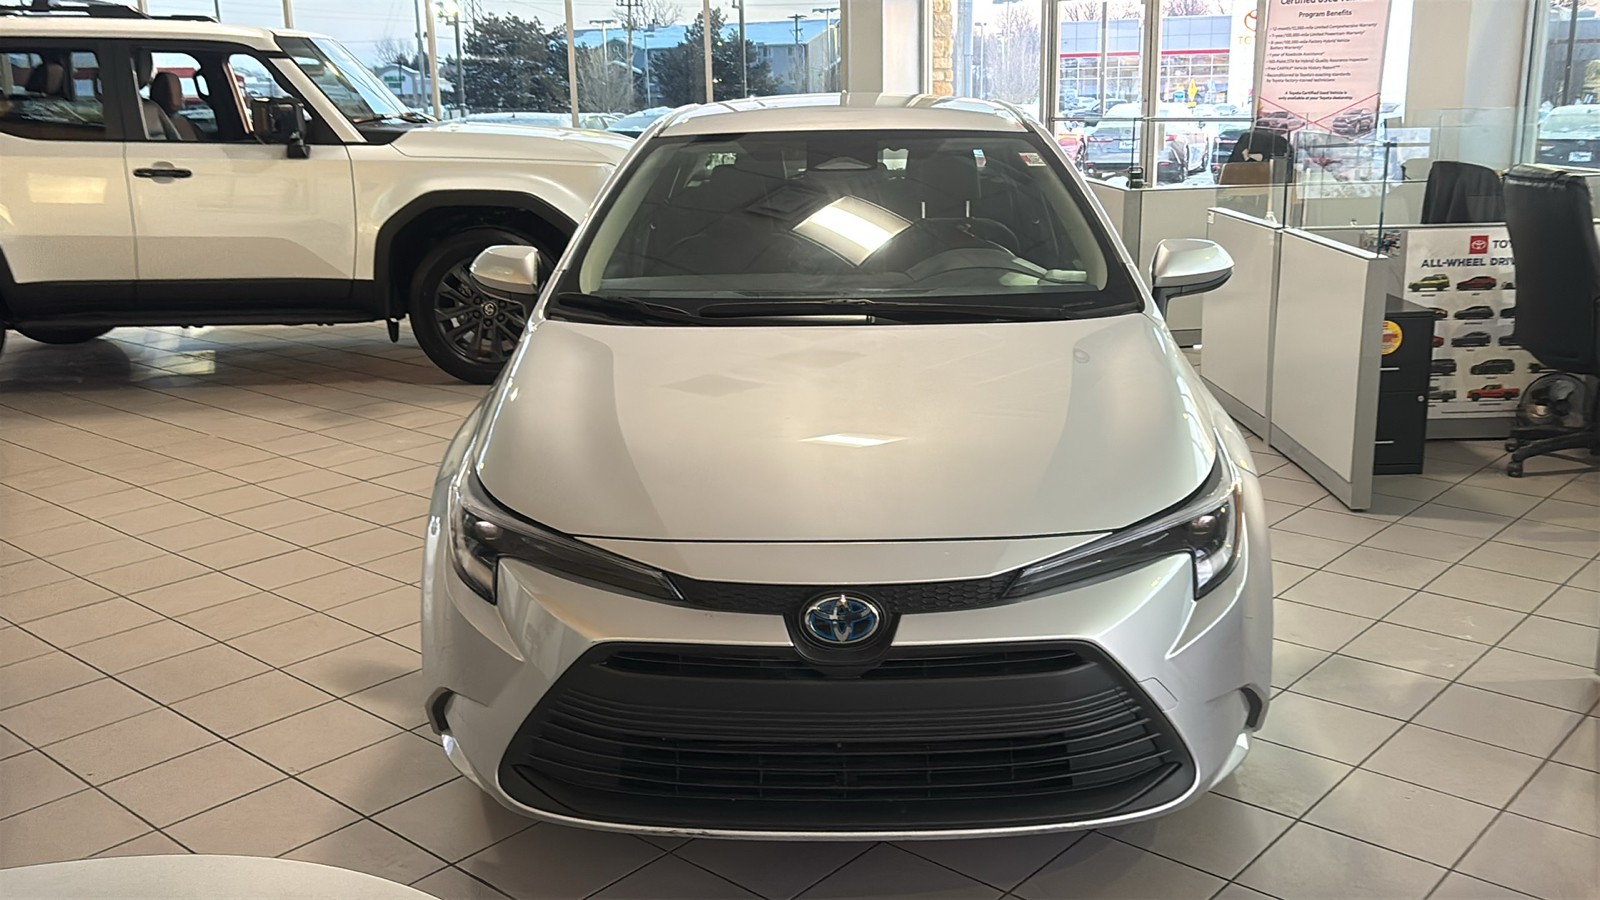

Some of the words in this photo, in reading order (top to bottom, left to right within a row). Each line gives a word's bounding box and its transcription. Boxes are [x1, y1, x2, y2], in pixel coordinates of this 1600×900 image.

[1298, 11, 1325, 19] Program
[1238, 35, 1256, 45] TO
[1492, 239, 1512, 249] TO
[1421, 258, 1486, 268] ALL-WHEEL
